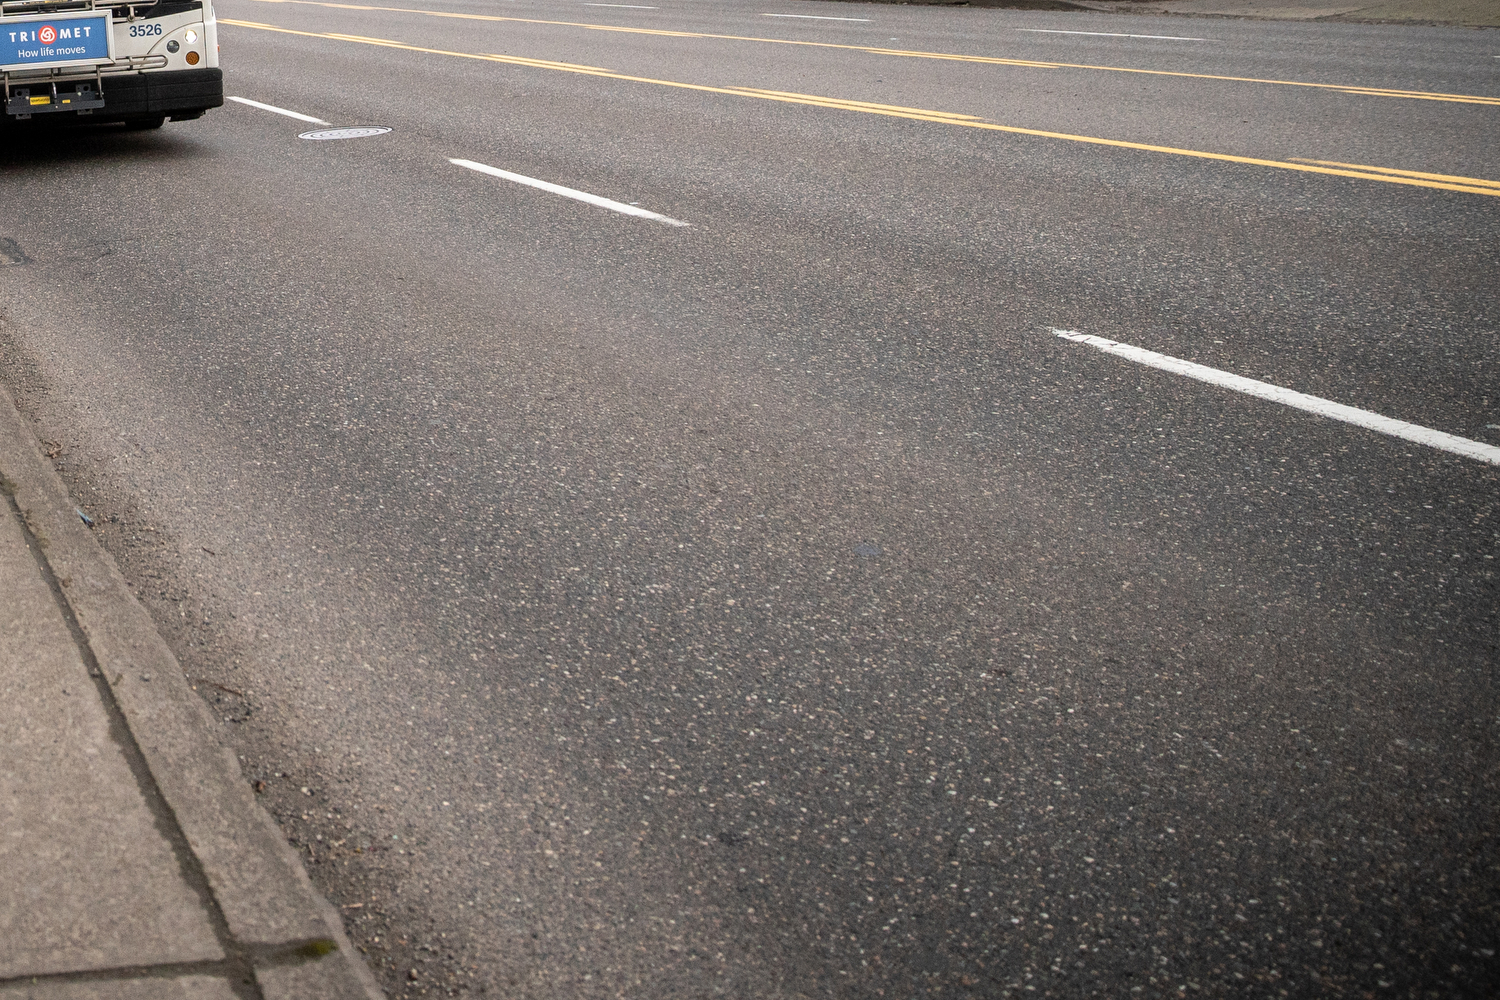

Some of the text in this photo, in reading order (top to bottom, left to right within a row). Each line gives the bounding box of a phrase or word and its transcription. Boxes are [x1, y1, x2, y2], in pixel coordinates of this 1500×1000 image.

[129, 23, 163, 38] 3526
[18, 45, 86, 58] How life moves
